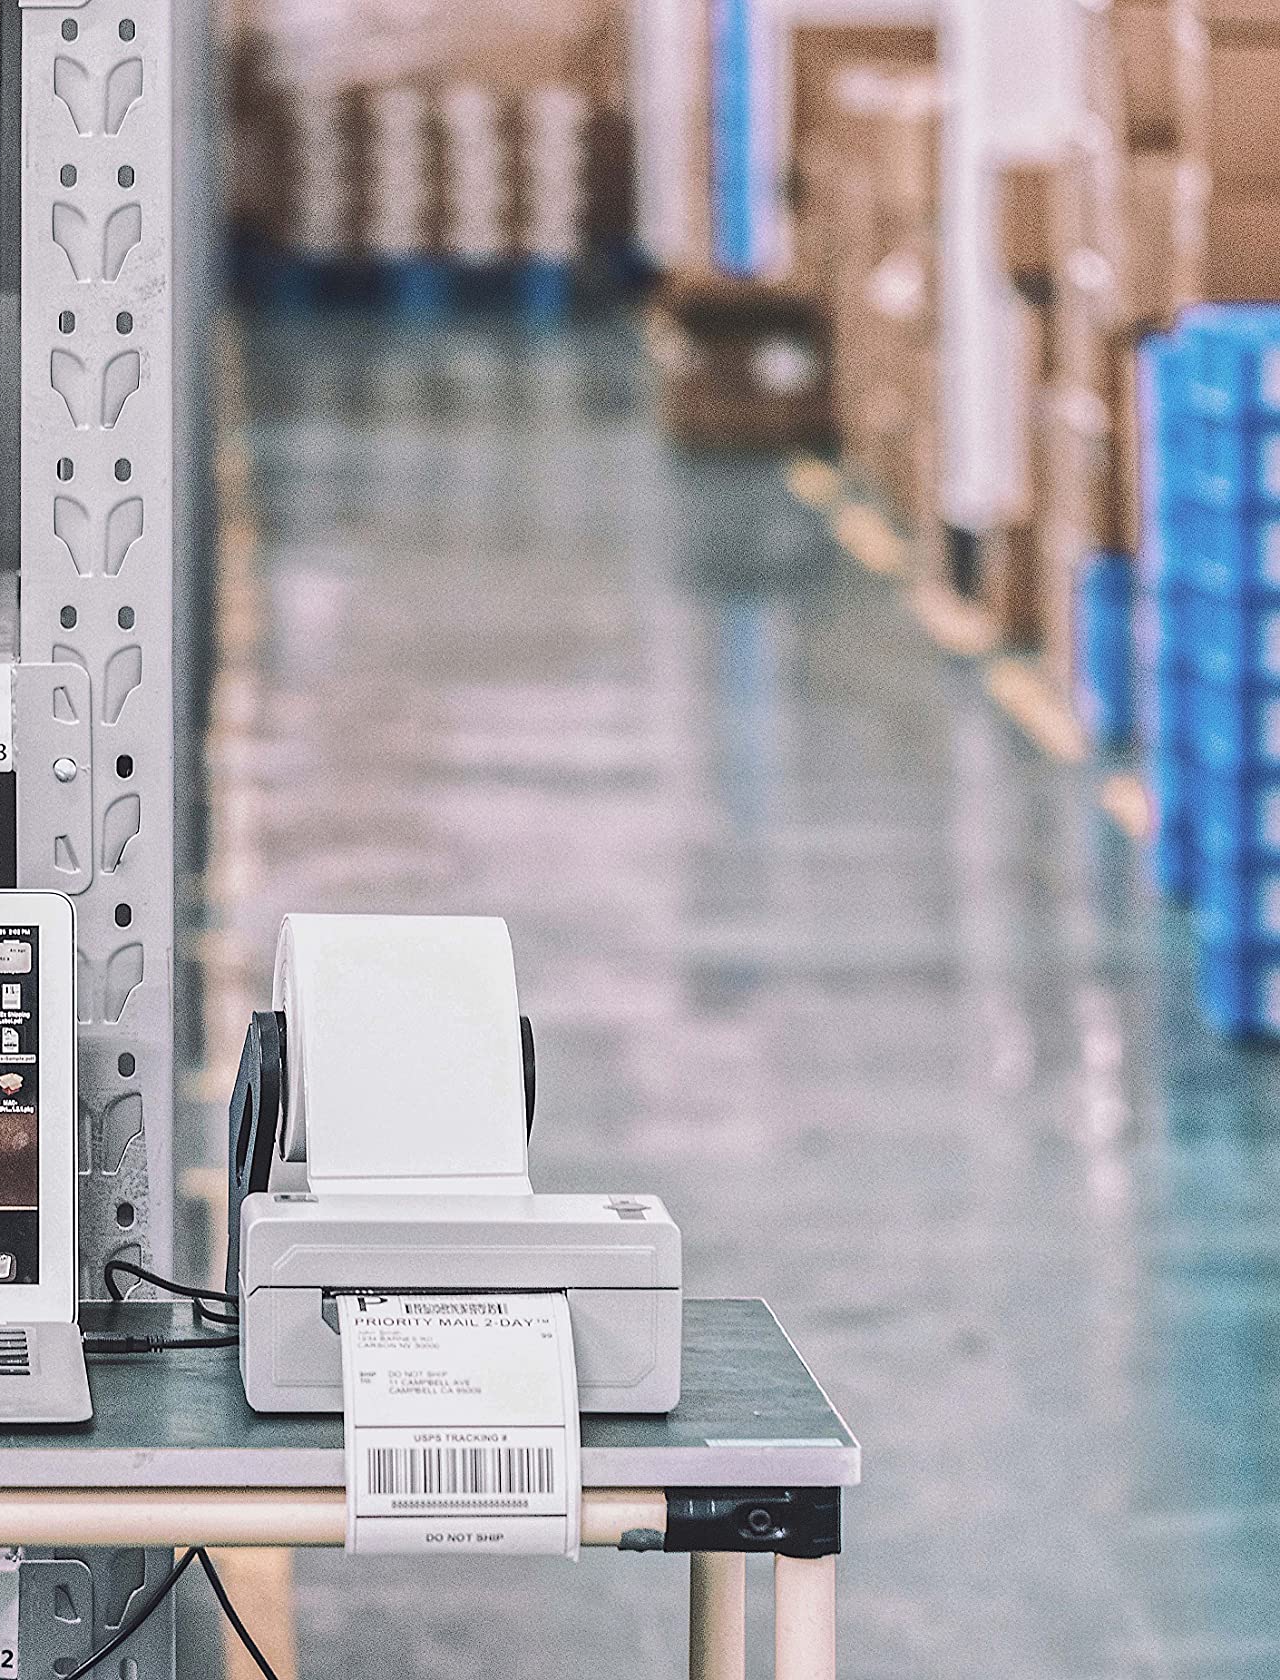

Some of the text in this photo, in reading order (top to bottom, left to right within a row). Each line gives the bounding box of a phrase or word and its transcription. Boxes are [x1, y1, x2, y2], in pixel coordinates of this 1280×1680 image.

[355, 1318, 432, 1327] PRIORITY
[439, 1318, 479, 1327] MAIL
[414, 1434, 442, 1442] USPS
[445, 1434, 499, 1442] TRACKING
[426, 1533, 504, 1542] DO NOT SHIP
